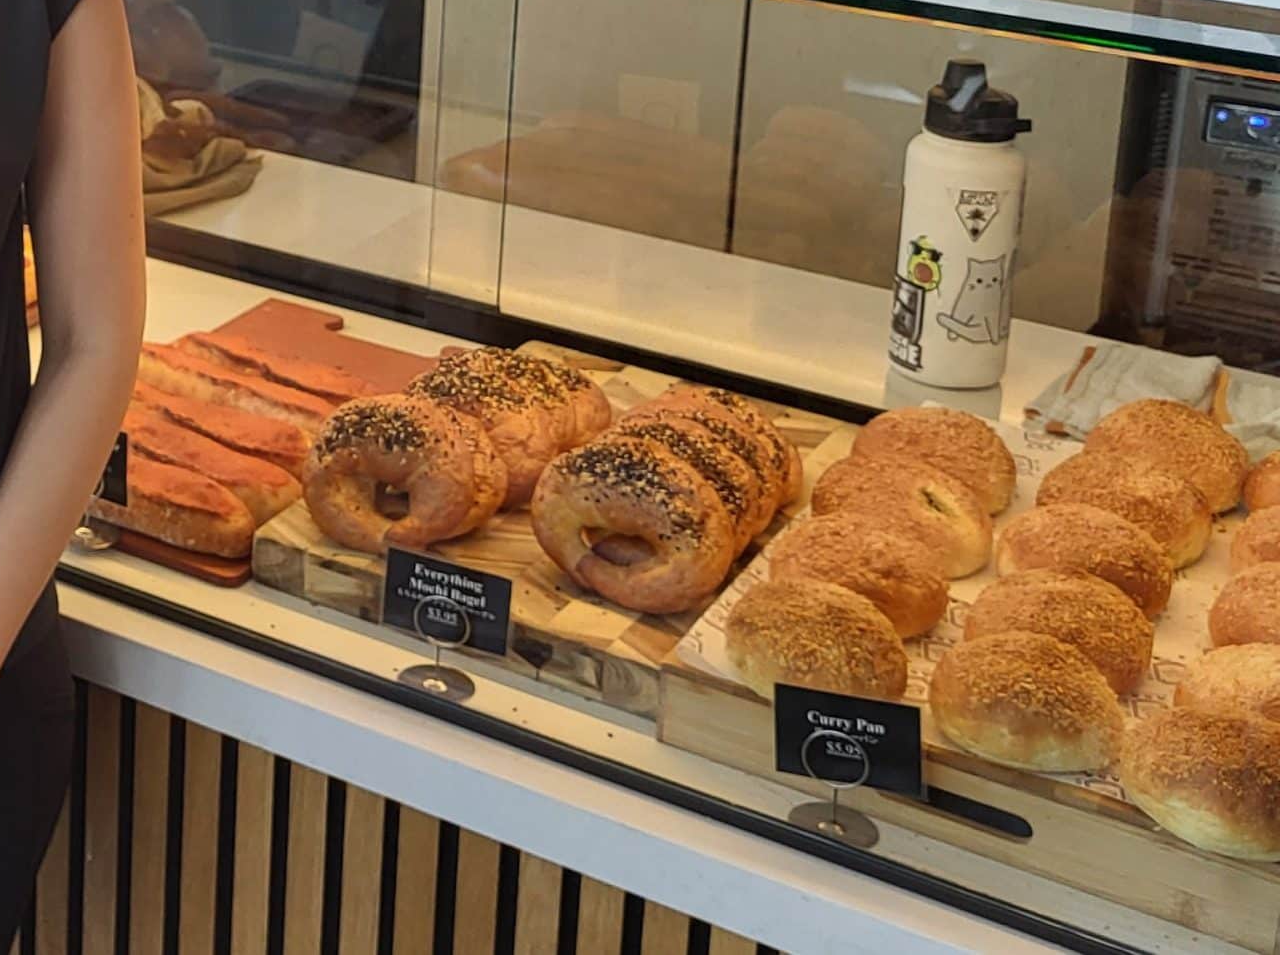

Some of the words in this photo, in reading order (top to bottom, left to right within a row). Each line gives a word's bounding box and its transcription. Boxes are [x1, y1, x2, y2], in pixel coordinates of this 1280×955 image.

[409, 576, 449, 597] Mochi
[450, 588, 487, 609] Bagel
[415, 563, 484, 593] Everything
[807, 709, 853, 732] Curry
[856, 717, 886, 735] Pan
